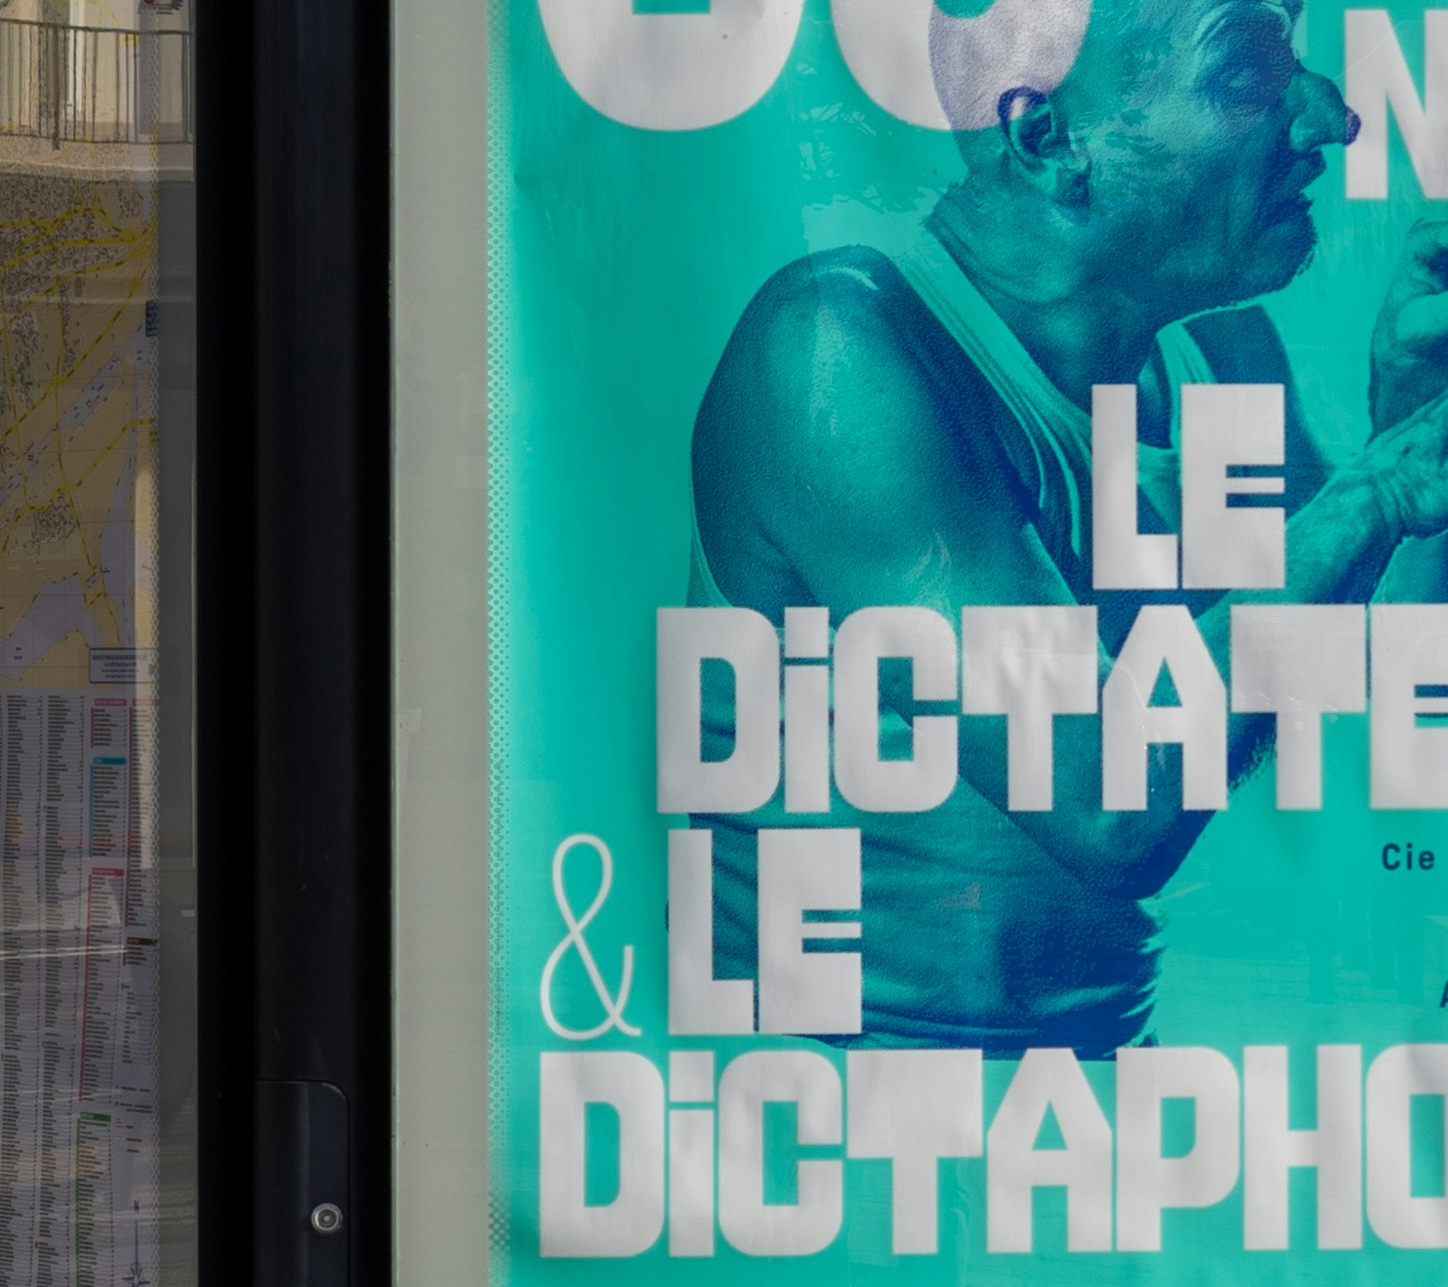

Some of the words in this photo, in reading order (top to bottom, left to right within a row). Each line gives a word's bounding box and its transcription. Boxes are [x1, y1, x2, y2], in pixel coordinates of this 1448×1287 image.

[1091, 383, 1286, 592] LE
[541, 832, 642, 1039] &
[666, 827, 863, 1036] LE
[1382, 843, 1436, 870] Cie
